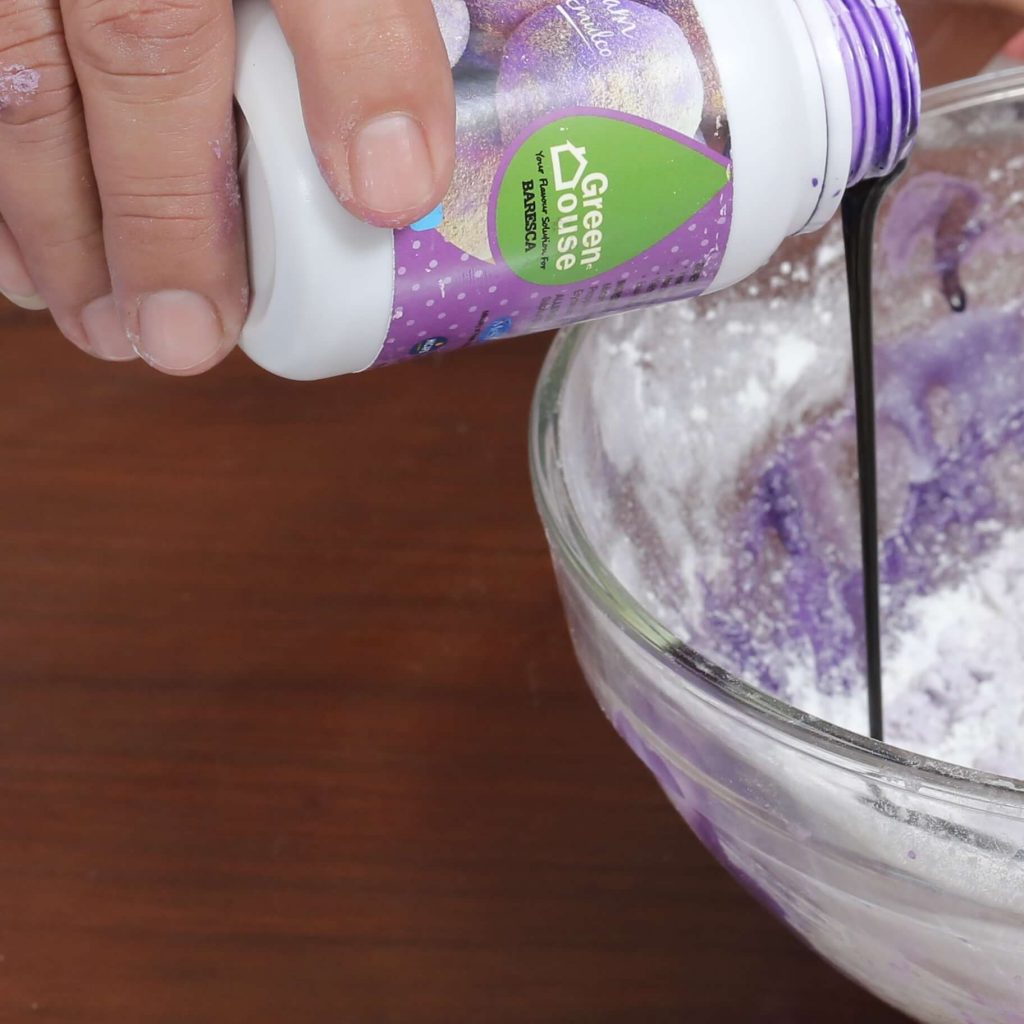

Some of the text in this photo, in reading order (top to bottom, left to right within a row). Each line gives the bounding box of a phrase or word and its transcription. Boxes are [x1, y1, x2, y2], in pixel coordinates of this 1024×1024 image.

[535, 150, 545, 175] Your
[539, 177, 549, 215] Flavour
[522, 179, 537, 253] BARESCA
[580, 171, 609, 266] Green
[540, 256, 549, 270] For
